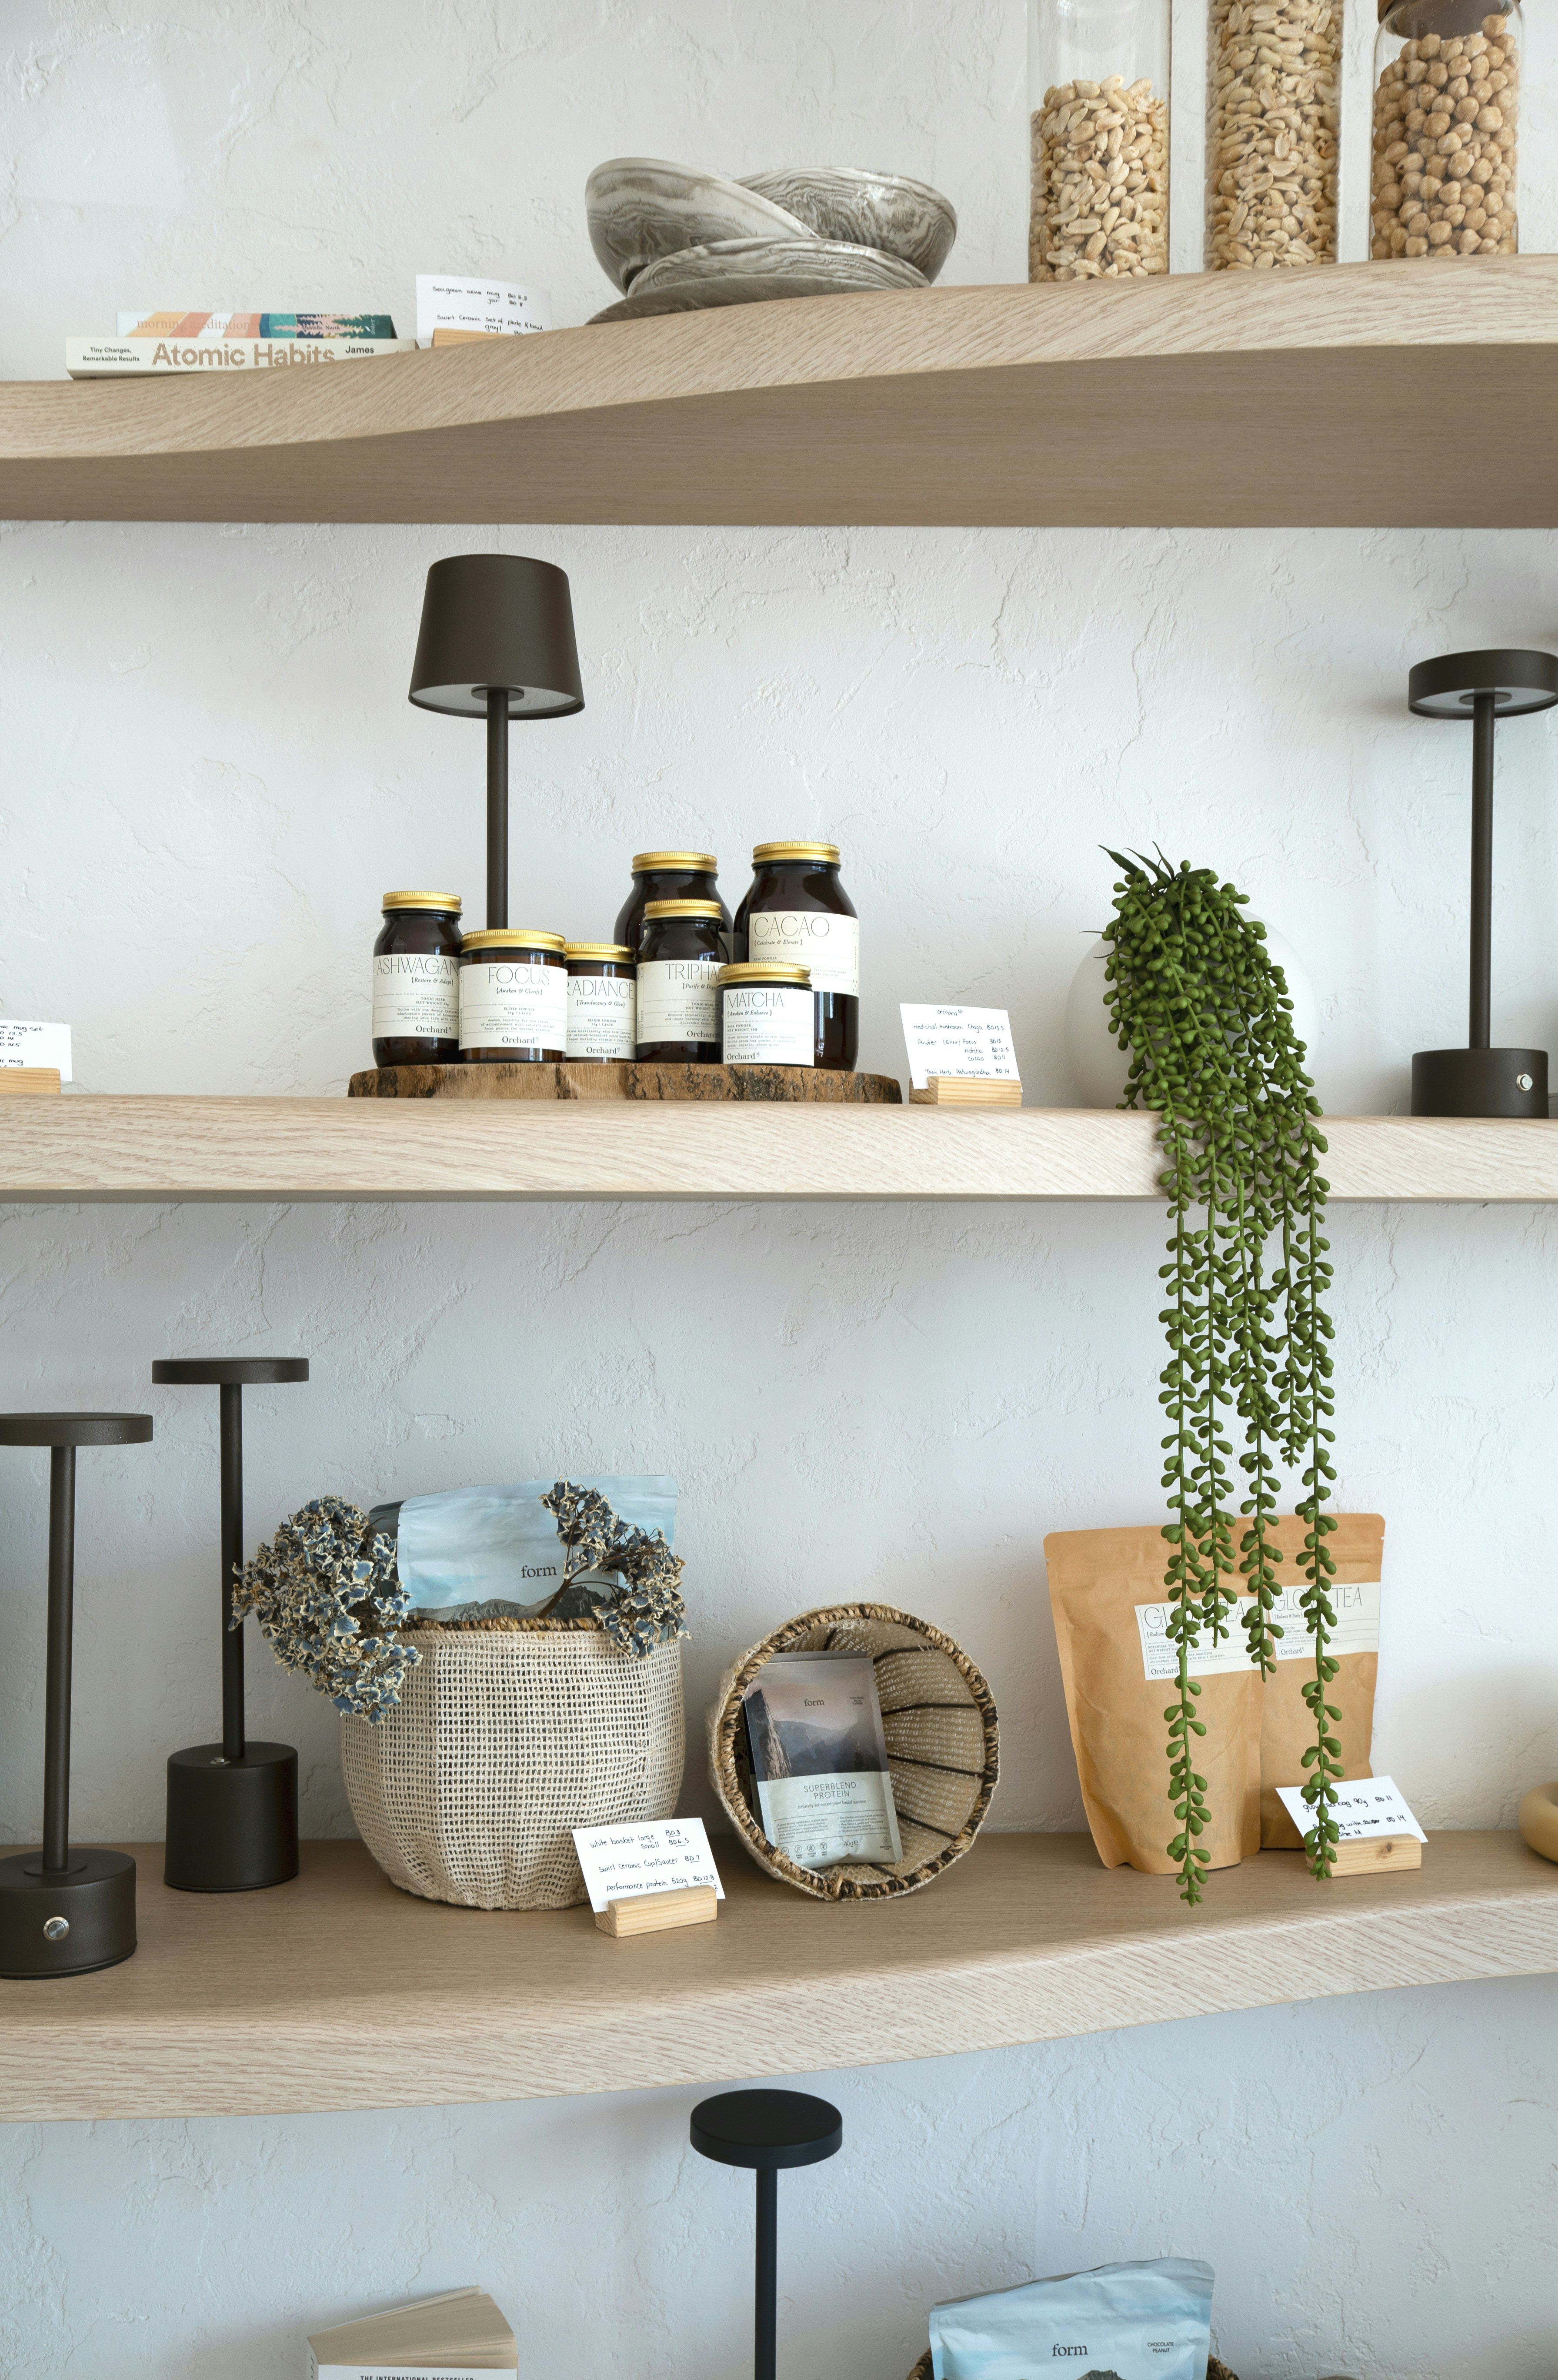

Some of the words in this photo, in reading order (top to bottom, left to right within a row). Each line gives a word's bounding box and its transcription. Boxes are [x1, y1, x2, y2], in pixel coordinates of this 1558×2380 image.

[137, 319, 186, 331] morning
[529, 322, 544, 331] bowl
[151, 341, 246, 366] Atomic
[253, 341, 335, 366] Habits
[345, 345, 374, 354] James
[754, 916, 830, 937] CACAO
[488, 966, 550, 986] FOCUS
[727, 992, 784, 1008] MATCHA
[416, 1025, 448, 1034] Orchard
[967, 1023, 983, 1033] Chaga
[956, 1069, 991, 1077] Ashwagandha
[521, 1565, 557, 1578] form
[1331, 1587, 1362, 1608] TEA
[1151, 1666, 1178, 1675] Orchard
[804, 1698, 825, 1707] form
[804, 1782, 856, 1792] SUPERBLEND
[814, 1790, 850, 1800] PROTEIN
[590, 1839, 607, 1848] white
[610, 1836, 634, 1845] basket
[637, 1835, 654, 1843] large
[607, 1882, 643, 1892] performance
[646, 1879, 668, 1889] protein
[671, 1877, 689, 1888] 520g
[1052, 2343, 1088, 2357] form
